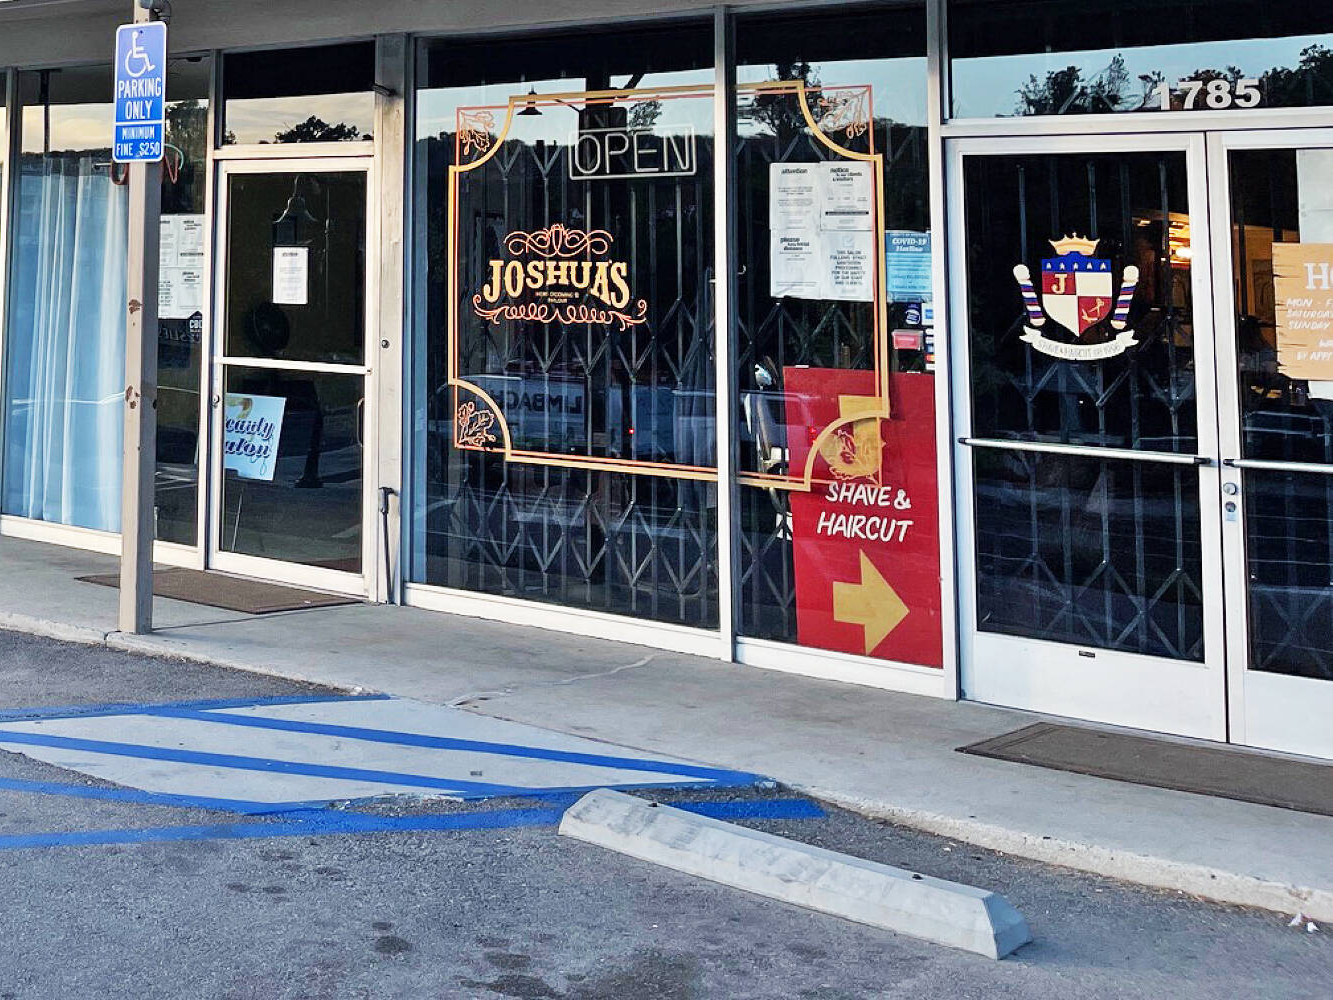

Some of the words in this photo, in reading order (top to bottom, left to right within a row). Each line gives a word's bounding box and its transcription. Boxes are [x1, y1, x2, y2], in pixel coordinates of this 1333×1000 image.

[118, 77, 162, 99] PARKING
[1152, 78, 1262, 110] 1785
[125, 100, 153, 120] ONLY
[122, 126, 154, 140] MINIMUM
[117, 143, 133, 156] FINE
[139, 142, 161, 156] $250
[573, 130, 693, 174] OPEN
[891, 237, 928, 246] COVID-19
[483, 258, 630, 309] JOSHUA'S
[1051, 273, 1067, 295] J
[1304, 262, 1333, 291] H
[1286, 298, 1313, 308] MON
[1287, 308, 1333, 319] SATURDA
[1288, 320, 1331, 330] SUNDAY
[225, 416, 275, 441] eauty
[225, 438, 271, 458] alon
[825, 481, 891, 506] SHAVE
[894, 489, 912, 510] &
[817, 511, 914, 542] HAIRCUT
